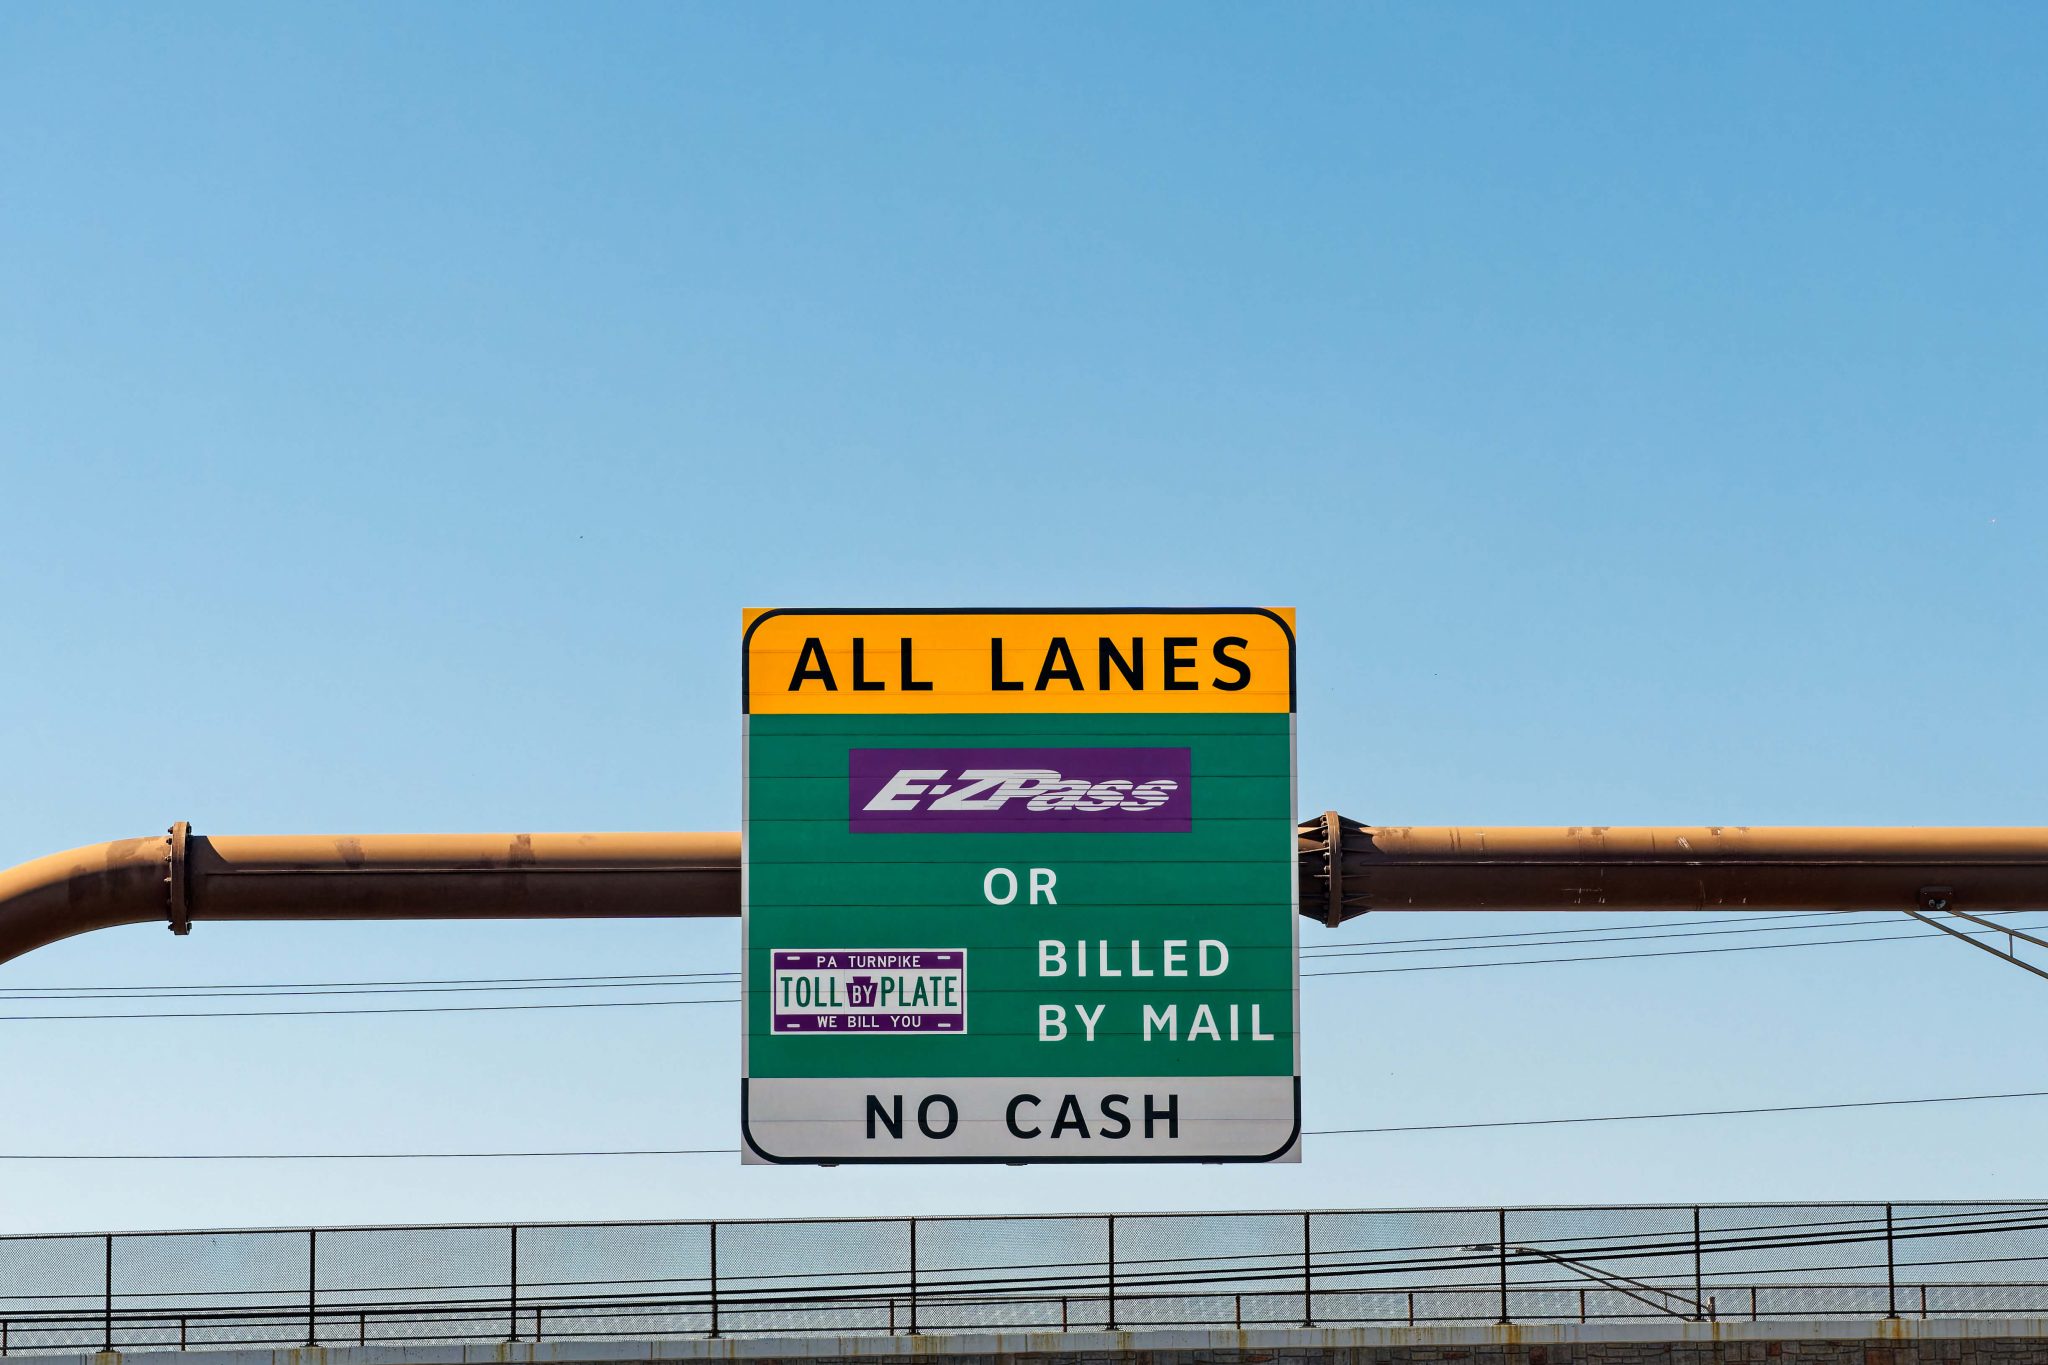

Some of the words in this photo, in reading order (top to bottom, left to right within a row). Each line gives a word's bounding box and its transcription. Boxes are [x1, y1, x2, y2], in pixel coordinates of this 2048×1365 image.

[788, 637, 934, 691] ALL
[990, 636, 1252, 691] LANES
[983, 867, 1058, 905] OR
[816, 956, 838, 968] PA
[848, 955, 921, 968] TURNPIKE
[1038, 939, 1229, 977] BILLED
[780, 976, 843, 1007] TOLL
[852, 985, 873, 1004] BY
[881, 976, 958, 1007] PLATE
[817, 1015, 838, 1028] WE
[847, 1015, 880, 1028] BILL
[890, 1015, 922, 1028] YOU
[1038, 1004, 1106, 1042] BY
[1143, 1004, 1275, 1042] MAIL
[866, 1094, 960, 1139] NO
[1005, 1094, 1179, 1139] CASH
